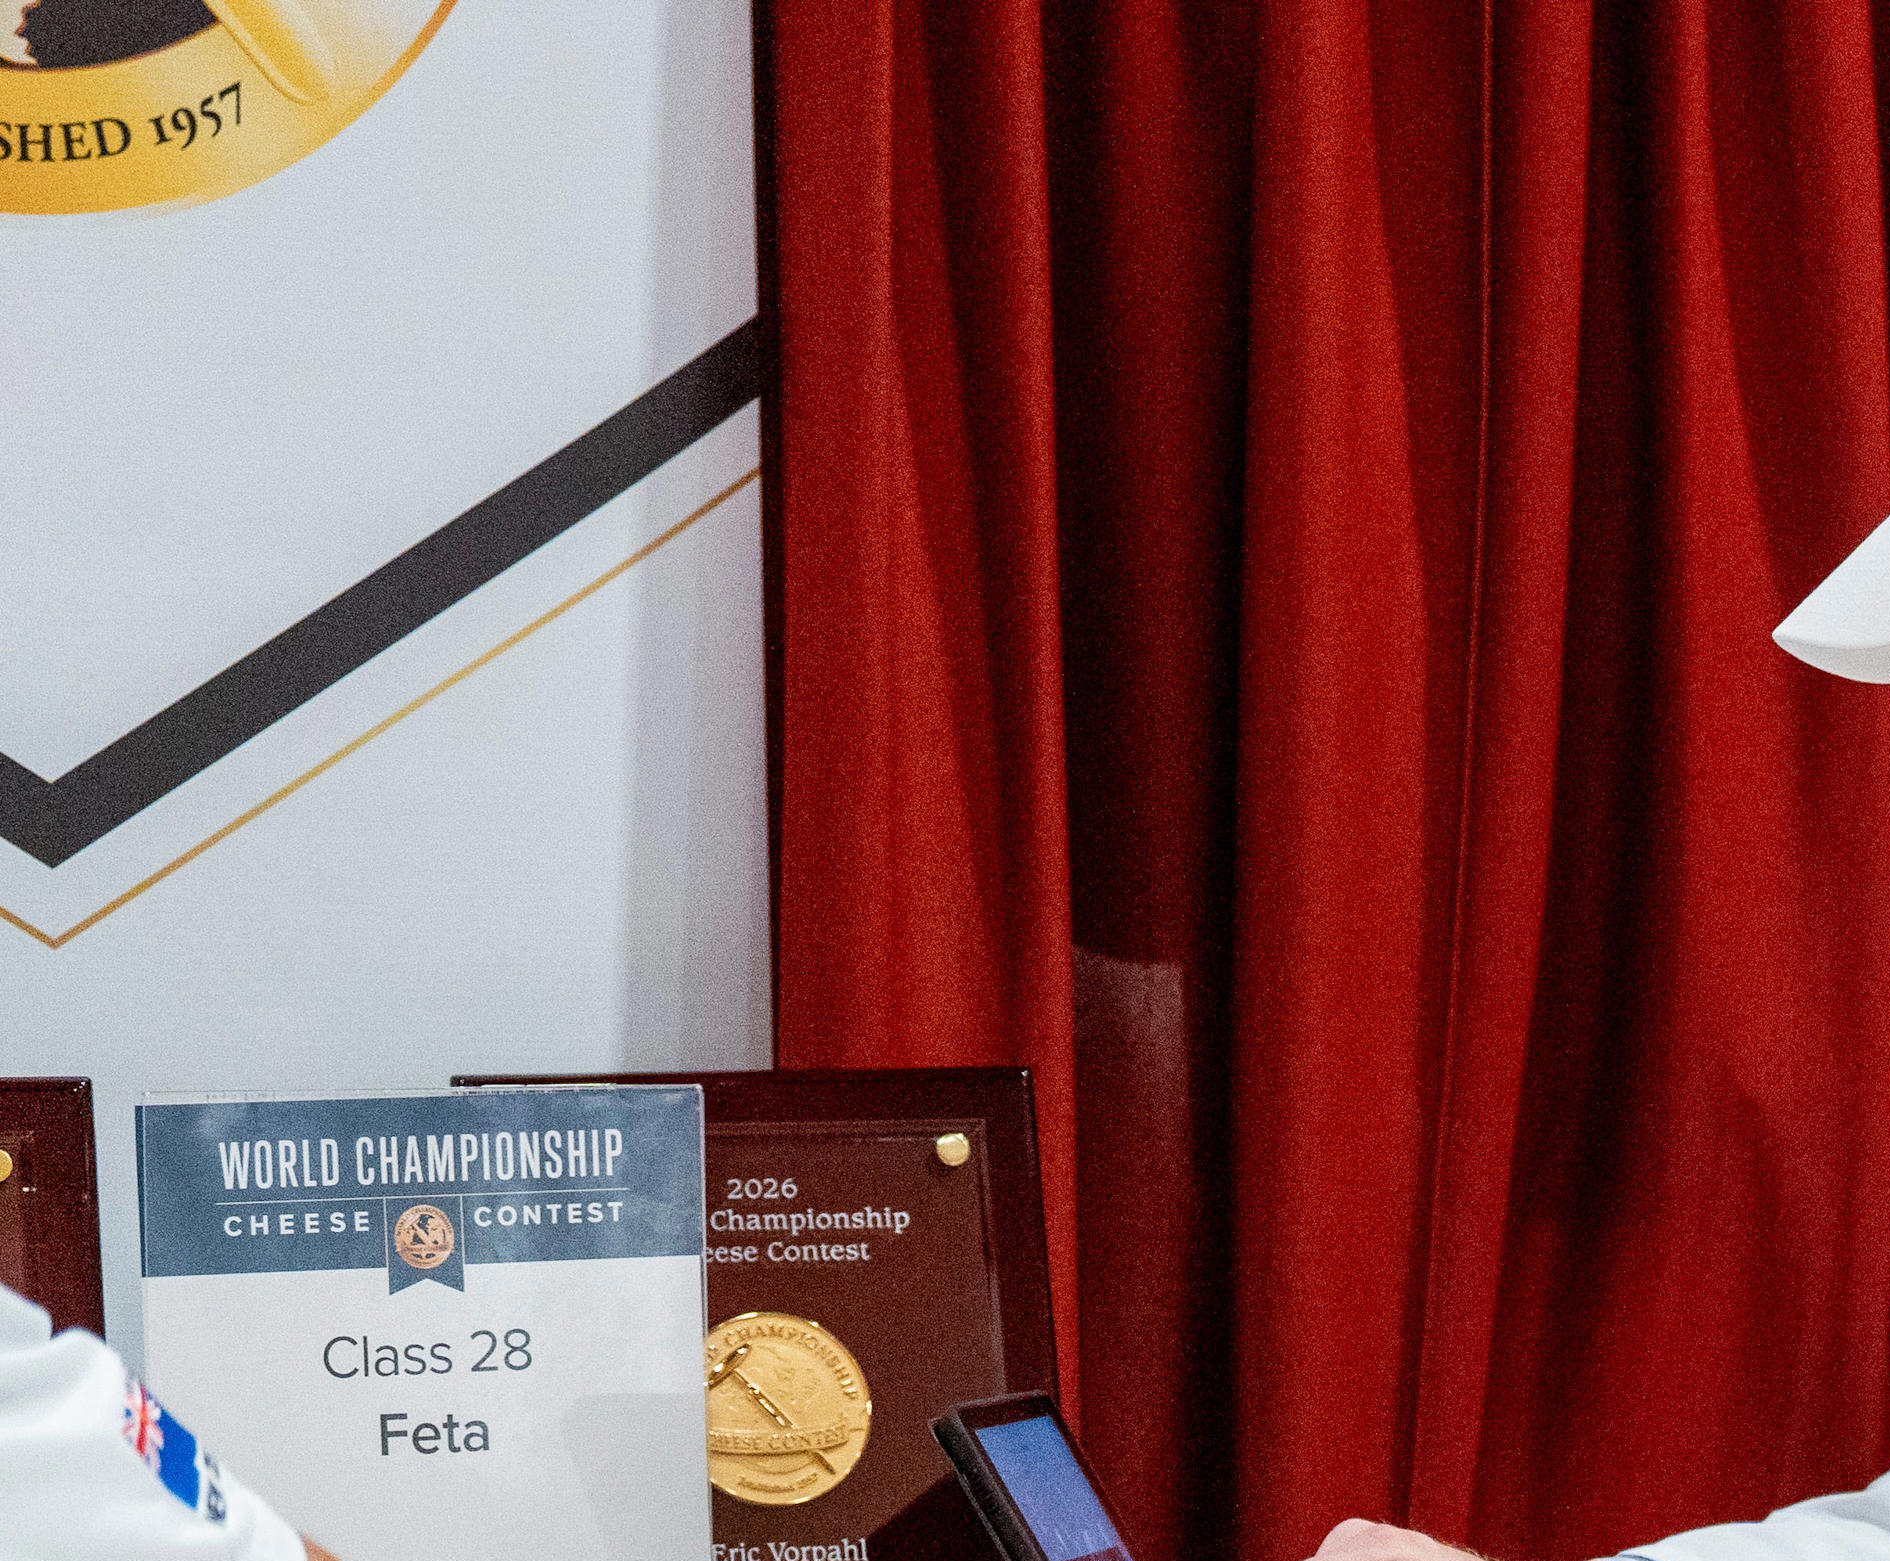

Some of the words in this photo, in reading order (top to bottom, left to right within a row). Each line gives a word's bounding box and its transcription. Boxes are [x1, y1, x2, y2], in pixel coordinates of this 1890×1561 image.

[0, 117, 131, 163] SHED
[149, 82, 243, 150] 1957
[219, 1138, 339, 1191] WORLD
[355, 1128, 623, 1186] CHAMPIONSHIP
[727, 1177, 798, 1200] 2026
[224, 1210, 370, 1238] CHEESE
[473, 1202, 624, 1228] CONTEST
[710, 1206, 910, 1236] Championship
[704, 1245, 758, 1263] eese
[767, 1241, 871, 1262] Contest
[323, 1335, 453, 1379] Class
[470, 1328, 533, 1373] 28
[380, 1413, 490, 1456] Feta
